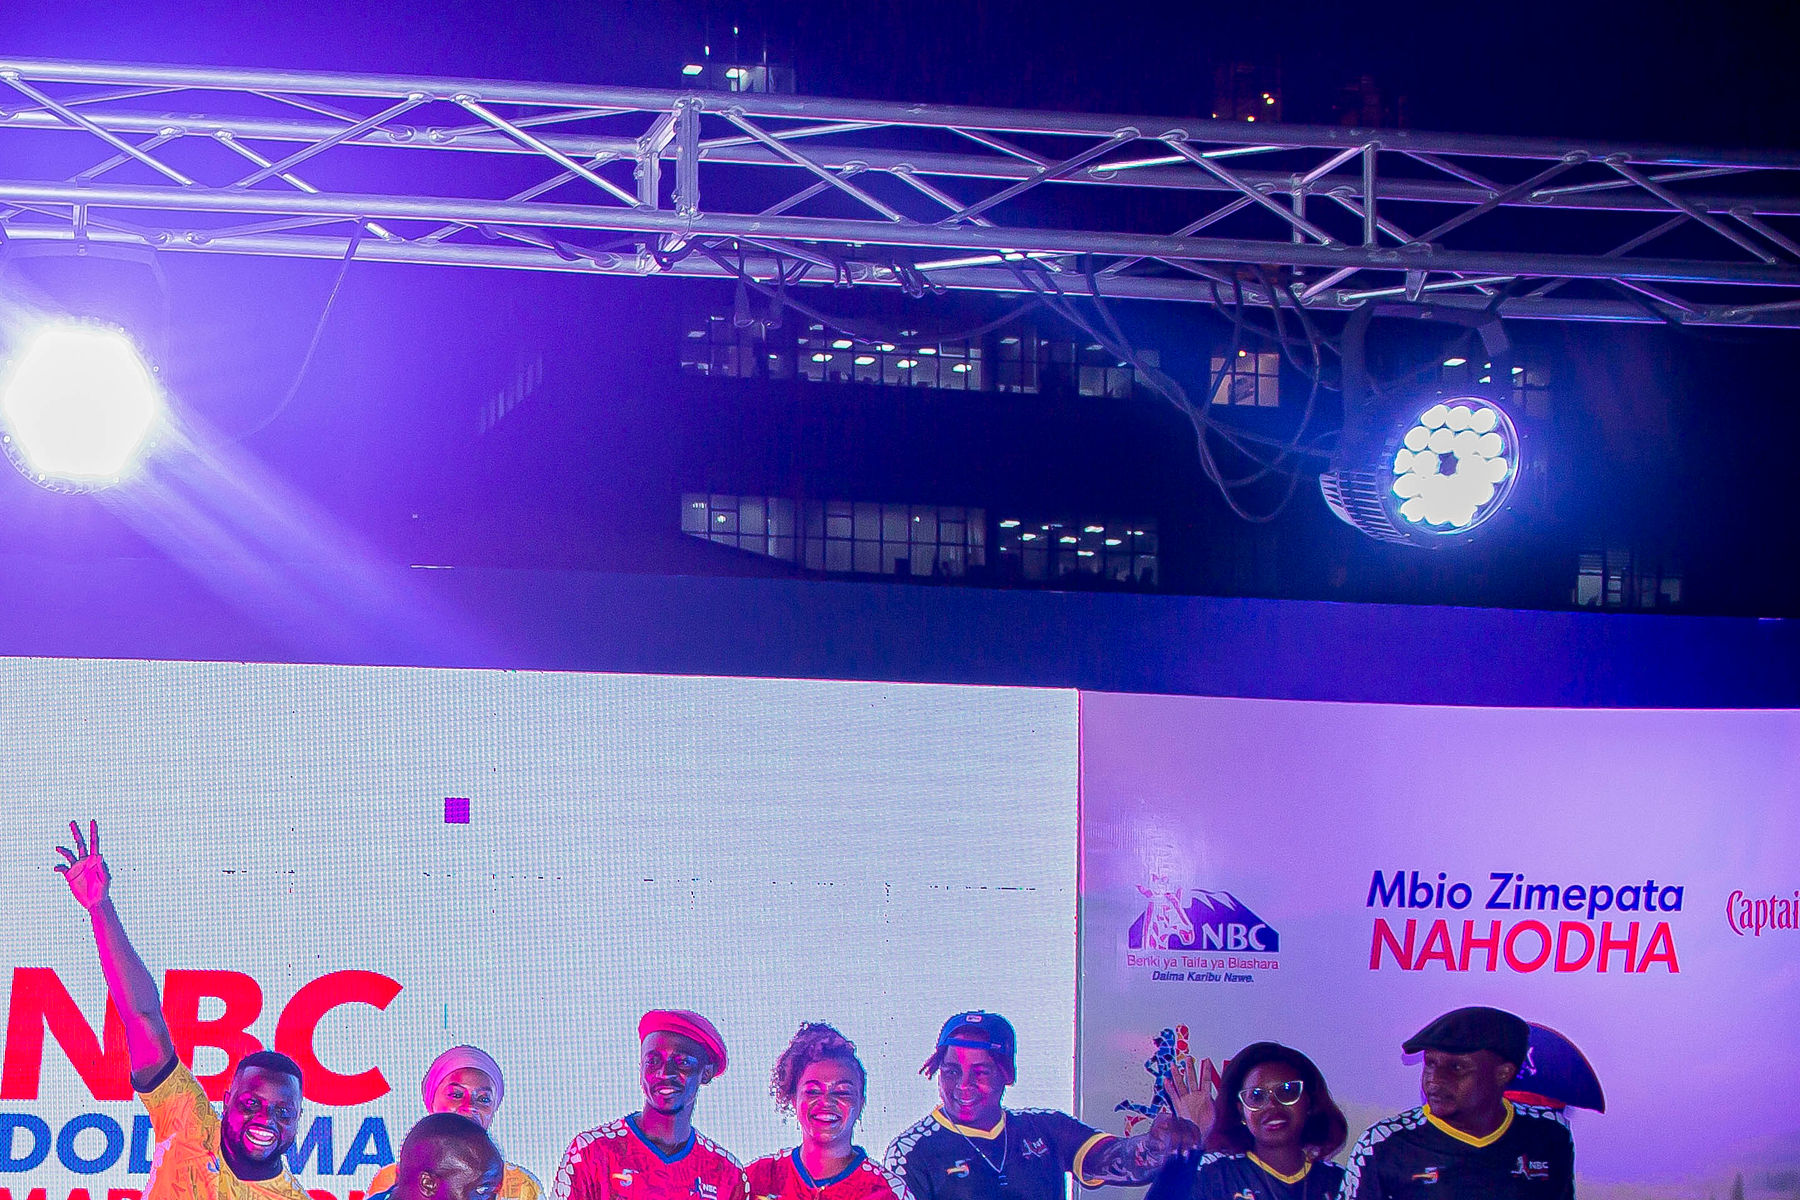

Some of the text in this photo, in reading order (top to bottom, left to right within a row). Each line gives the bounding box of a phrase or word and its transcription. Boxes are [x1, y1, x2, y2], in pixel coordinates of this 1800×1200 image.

[1366, 870, 1684, 919] Mbio Zimepata
[1726, 890, 1800, 937] Captai
[1202, 922, 1267, 951] NBC
[1369, 918, 1681, 973] NAHODHA
[1164, 957, 1177, 970] ya
[1211, 958, 1225, 970] ya
[1228, 957, 1279, 969] Biashara
[1187, 972, 1221, 982] Karibu
[0, 966, 404, 1107] NBC
[1529, 1160, 1549, 1170] NBC
